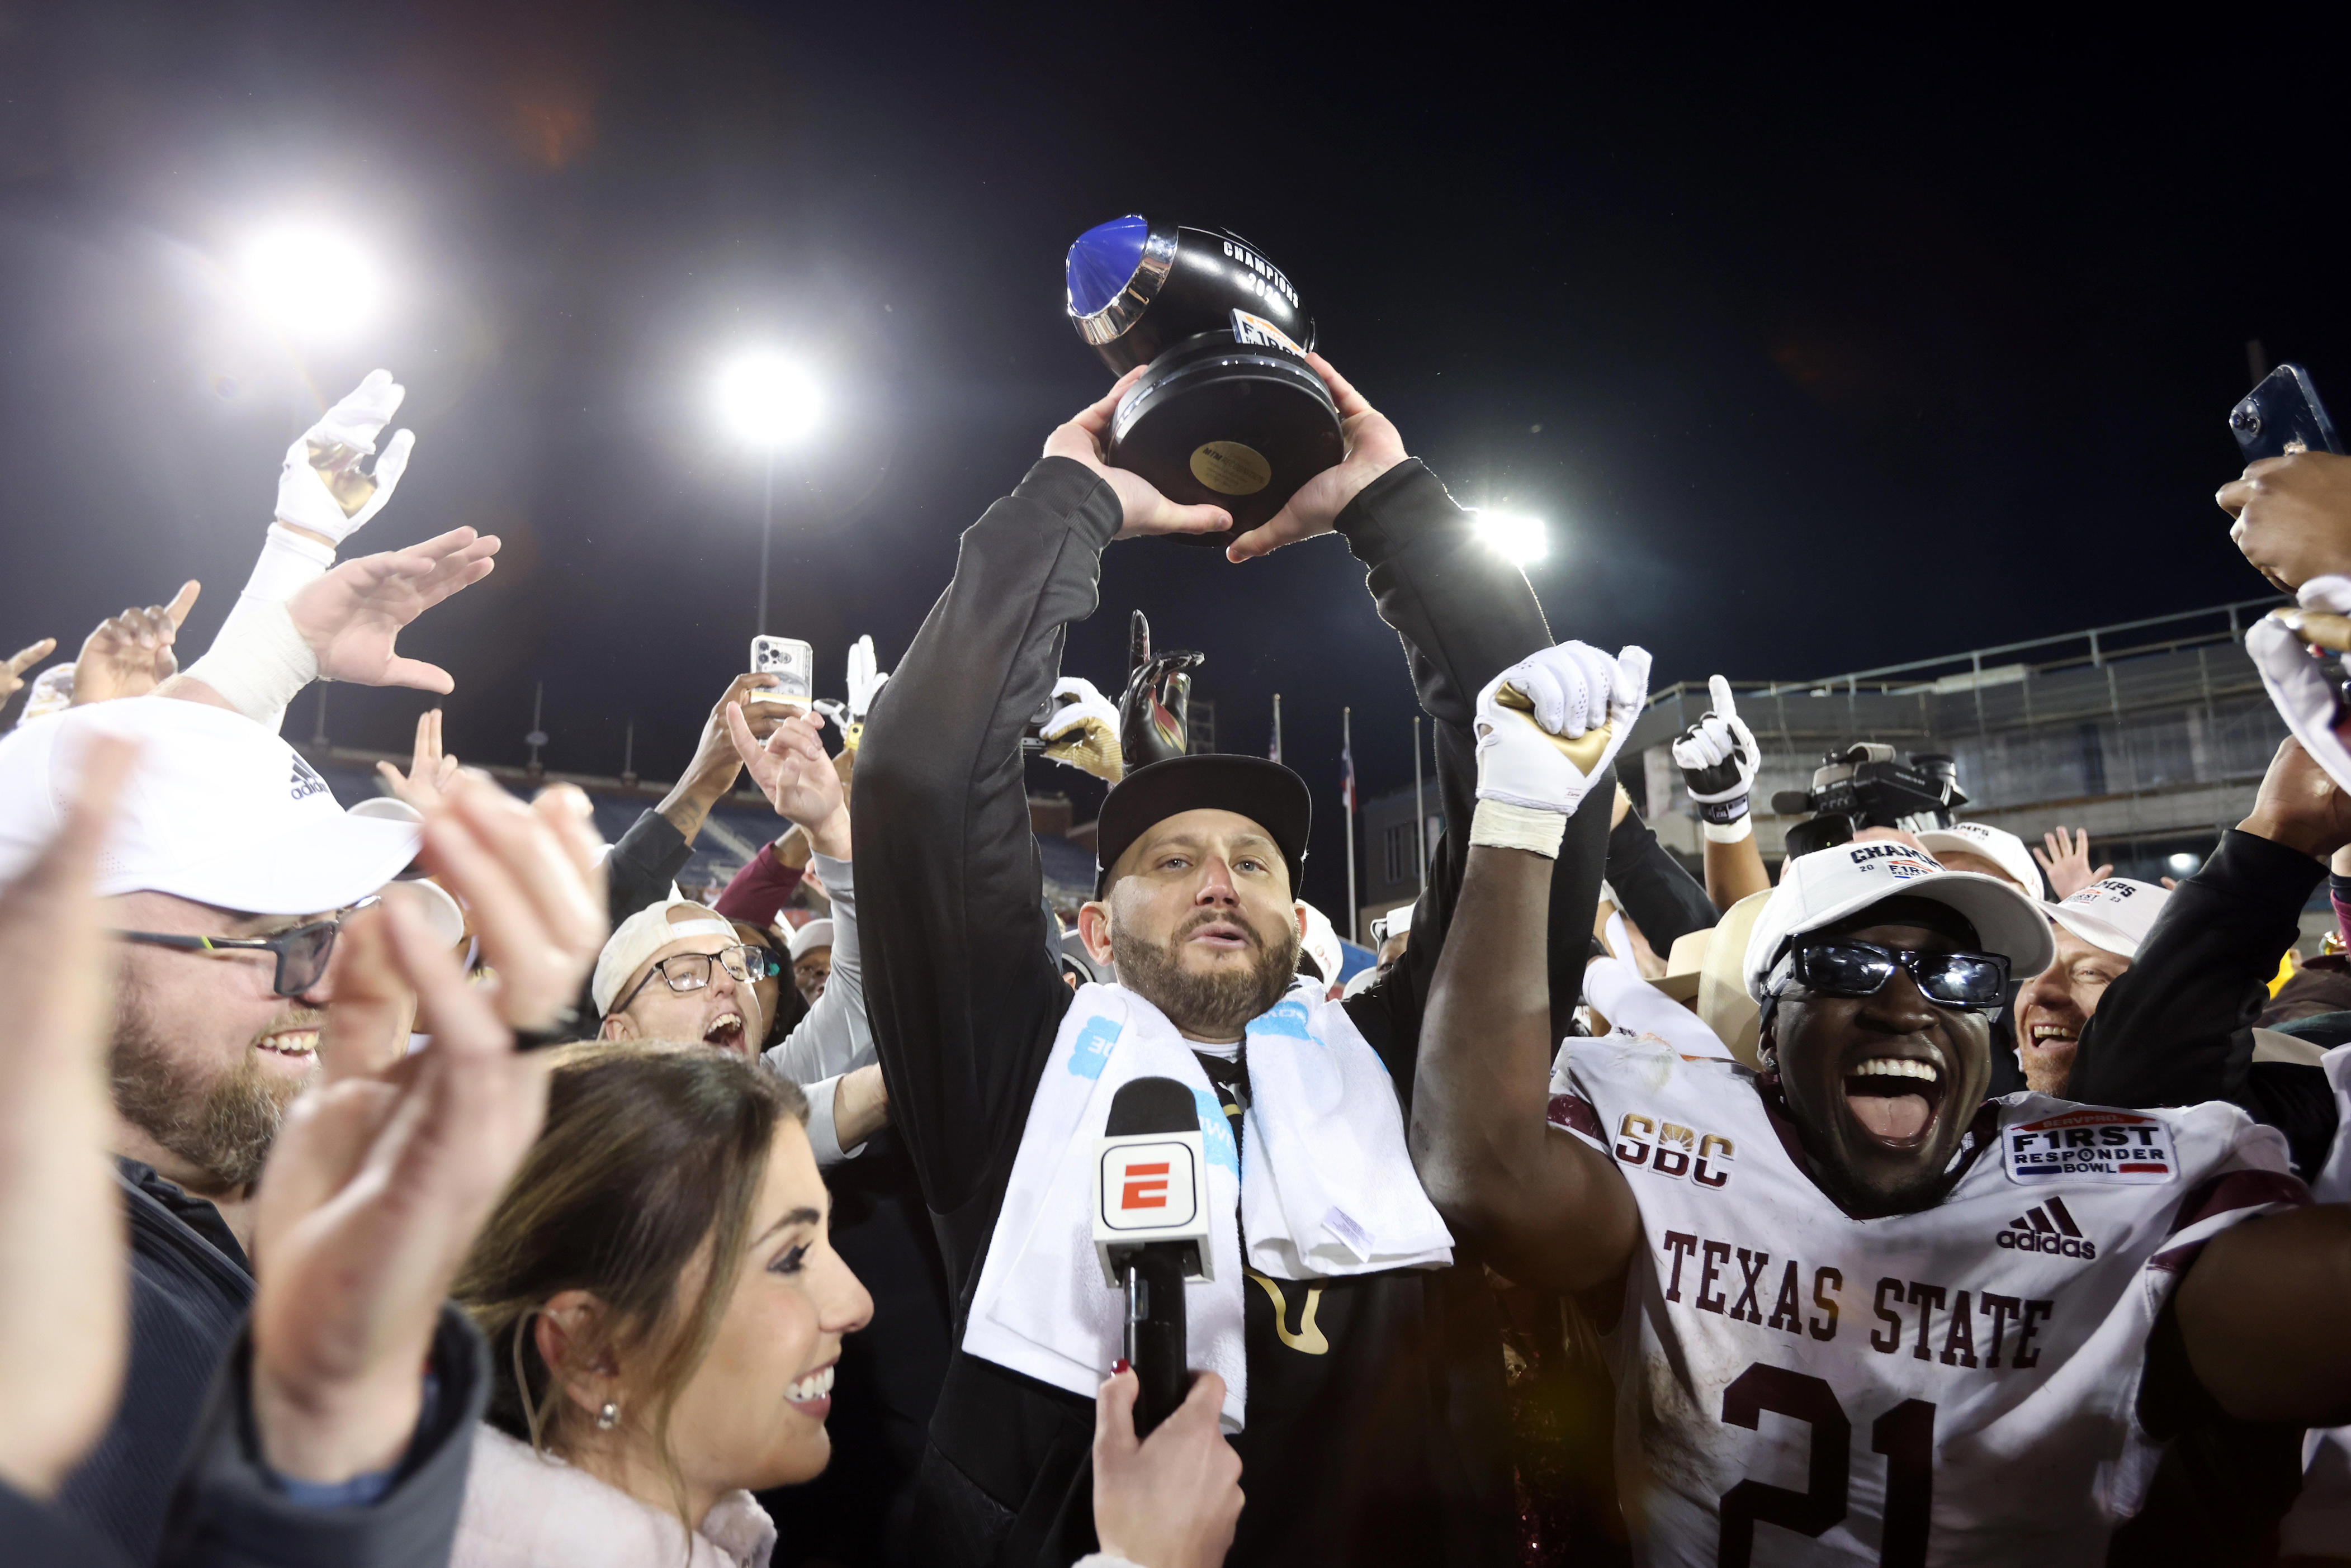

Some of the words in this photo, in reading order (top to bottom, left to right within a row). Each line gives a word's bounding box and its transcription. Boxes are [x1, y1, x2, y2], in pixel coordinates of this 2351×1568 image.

[1223, 241, 1299, 309] CHAMPIONS
[2013, 1126, 2159, 1152] F1RST
[2042, 1115, 2118, 1127] SERVPRO
[1615, 1113, 1735, 1188] SBC
[2014, 1148, 2165, 1164] RESPONDER
[2063, 1163, 2117, 1173] BOWL
[1122, 1162, 1170, 1209] E
[1996, 1229, 2096, 1260] adidas
[1663, 1230, 1843, 1342] TEXAS
[1870, 1276, 2054, 1370] STATE
[1718, 1362, 1937, 1568] 21
